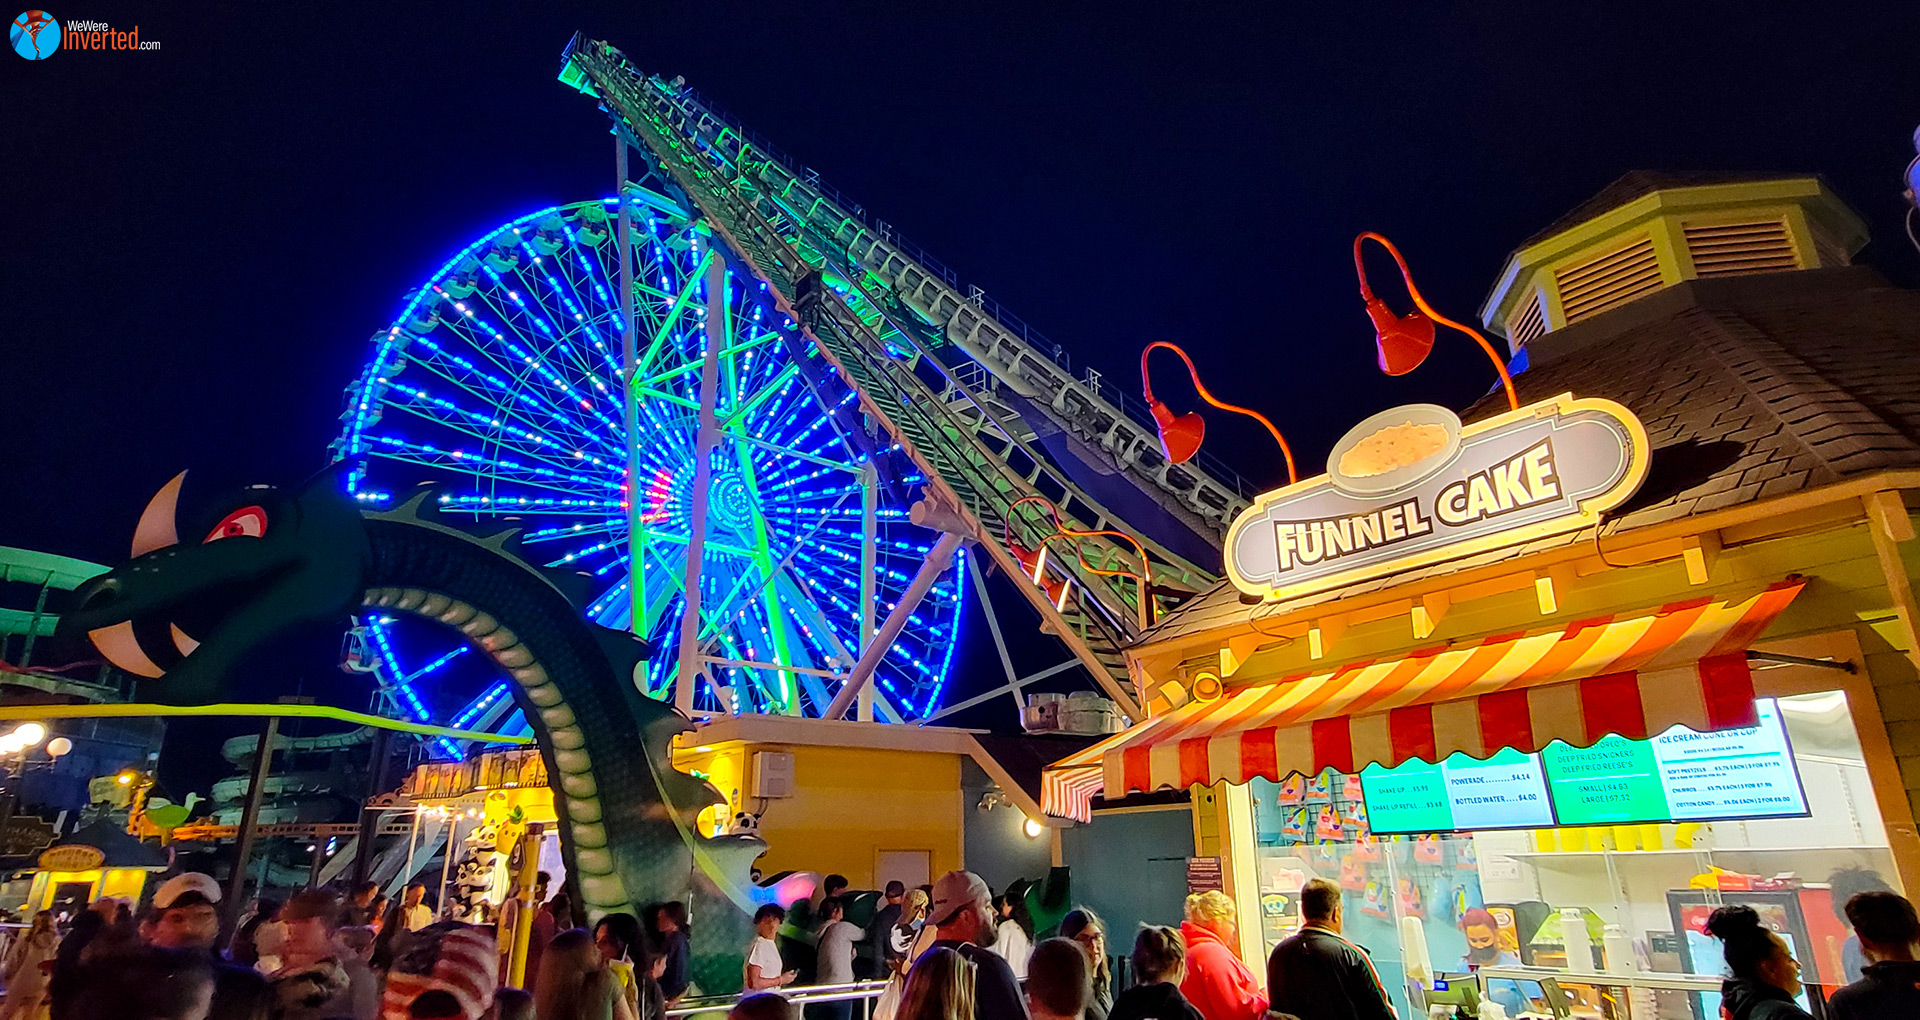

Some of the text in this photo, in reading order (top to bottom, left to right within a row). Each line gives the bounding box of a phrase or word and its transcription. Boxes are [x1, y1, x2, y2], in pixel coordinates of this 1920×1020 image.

[1274, 440, 1561, 571] FUNNEL CAKE
[1659, 735, 1672, 744] ICE
[1673, 733, 1701, 742] CREAM
[1557, 750, 1635, 763] DEEP FRIED SNICKERS
[1562, 761, 1634, 773] DEEP FRIED REESE'S
[1455, 797, 1483, 805] BOTTLED
